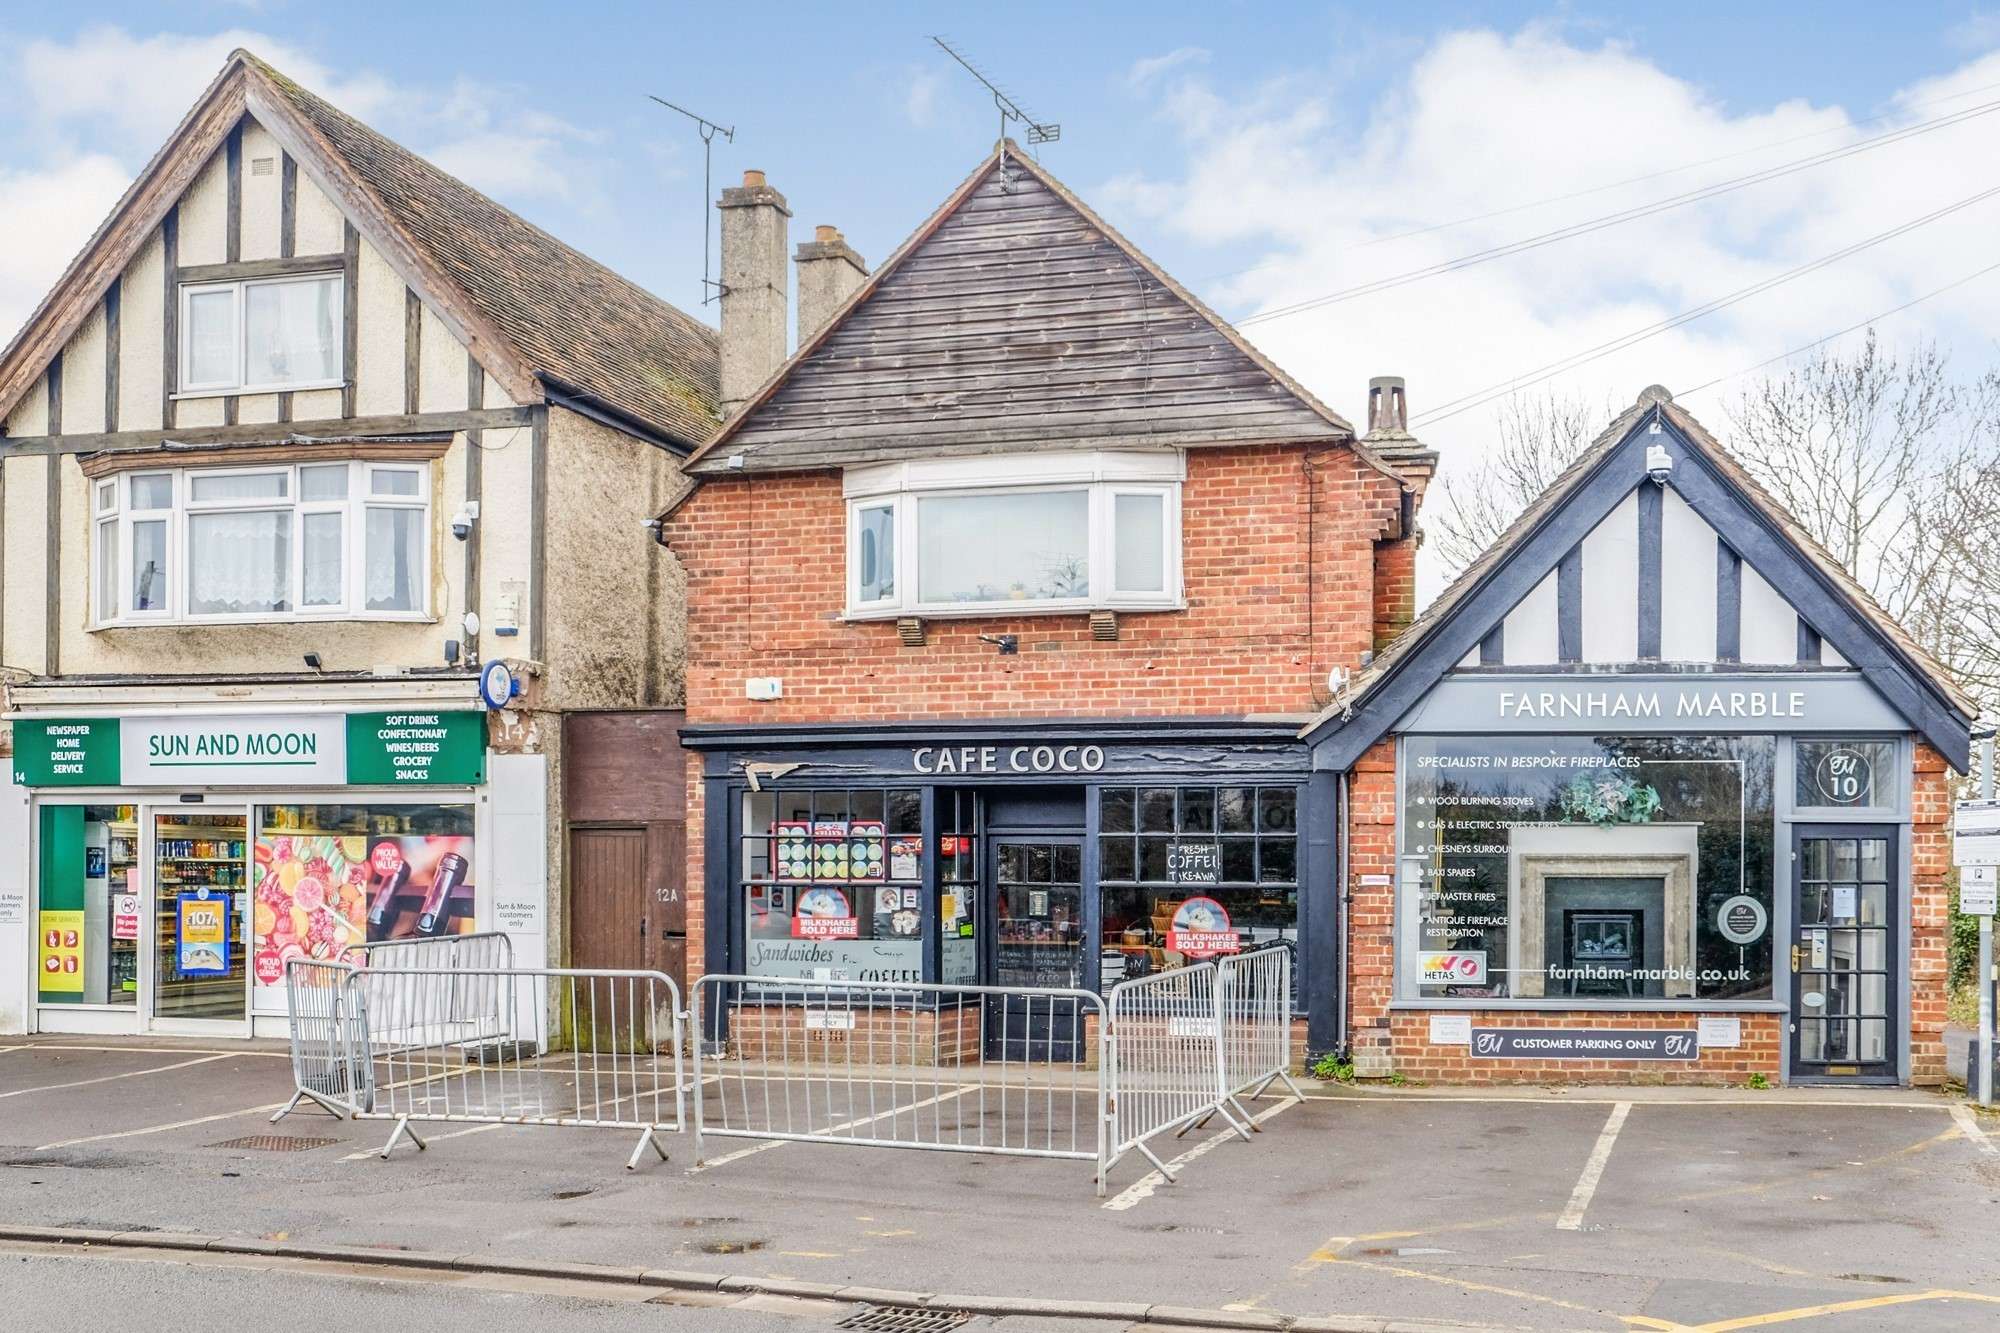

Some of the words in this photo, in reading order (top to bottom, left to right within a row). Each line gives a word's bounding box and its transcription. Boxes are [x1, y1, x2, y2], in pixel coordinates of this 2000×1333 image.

[1500, 692, 1661, 717] FARNHAM
[1676, 692, 1805, 717] MARBLE
[386, 716, 407, 726] SOFT
[408, 715, 439, 725] DRINKS
[46, 726, 90, 735] NEWSPAPER
[377, 729, 448, 739] CONFECTIONARY
[56, 738, 80, 748] HOME
[149, 734, 189, 756] SUN
[196, 734, 240, 756] AND
[246, 733, 316, 755] MOON
[386, 743, 439, 753] WINES/BEERS
[51, 751, 86, 761] DELIVERY
[393, 756, 432, 766] GROCERY
[913, 747, 997, 773] CAFE
[1010, 746, 1105, 772] COCO
[1417, 756, 1490, 768] SPECIALISTS
[1493, 757, 1507, 768] IN
[1511, 757, 1566, 768] BESPOKE
[1570, 757, 1640, 768] FIREPLACES
[53, 764, 84, 774] SERVICE
[15, 772, 26, 782] 14
[395, 770, 429, 780] SNACKS
[1830, 777, 1858, 796] 10
[1428, 797, 1459, 806] WOOD
[1461, 797, 1501, 806] BURNING
[1503, 797, 1534, 806] STOVES
[1428, 820, 1446, 830] GAS
[1447, 821, 1455, 830] &
[1456, 820, 1494, 830] ELECTRIC
[1496, 820, 1528, 830] STOVES
[1179, 844, 1208, 855] FRESH
[1427, 845, 1471, 854] CHESNEYS
[1447, 868, 1476, 877] SPARES
[656, 888, 678, 902] 12A
[1474, 892, 1496, 901] FIRES
[508, 919, 524, 928] only
[1426, 916, 1466, 925] ANTIQUE
[800, 926, 828, 935] SOLD
[829, 926, 857, 935] HERE
[1426, 928, 1484, 937] RESTORATION
[1176, 933, 1238, 941] MILKSHAKES
[1176, 941, 1205, 950] SOLD
[1208, 941, 1238, 950] HERE
[750, 941, 834, 966] Sandwiches
[1425, 971, 1455, 980] HETAS
[1550, 964, 1750, 981] farnham-marble.co.uk
[1513, 1038, 1573, 1049] CUSTOMER
[1575, 1039, 1623, 1049] PARKING
[1625, 1040, 1656, 1049] ONLY
